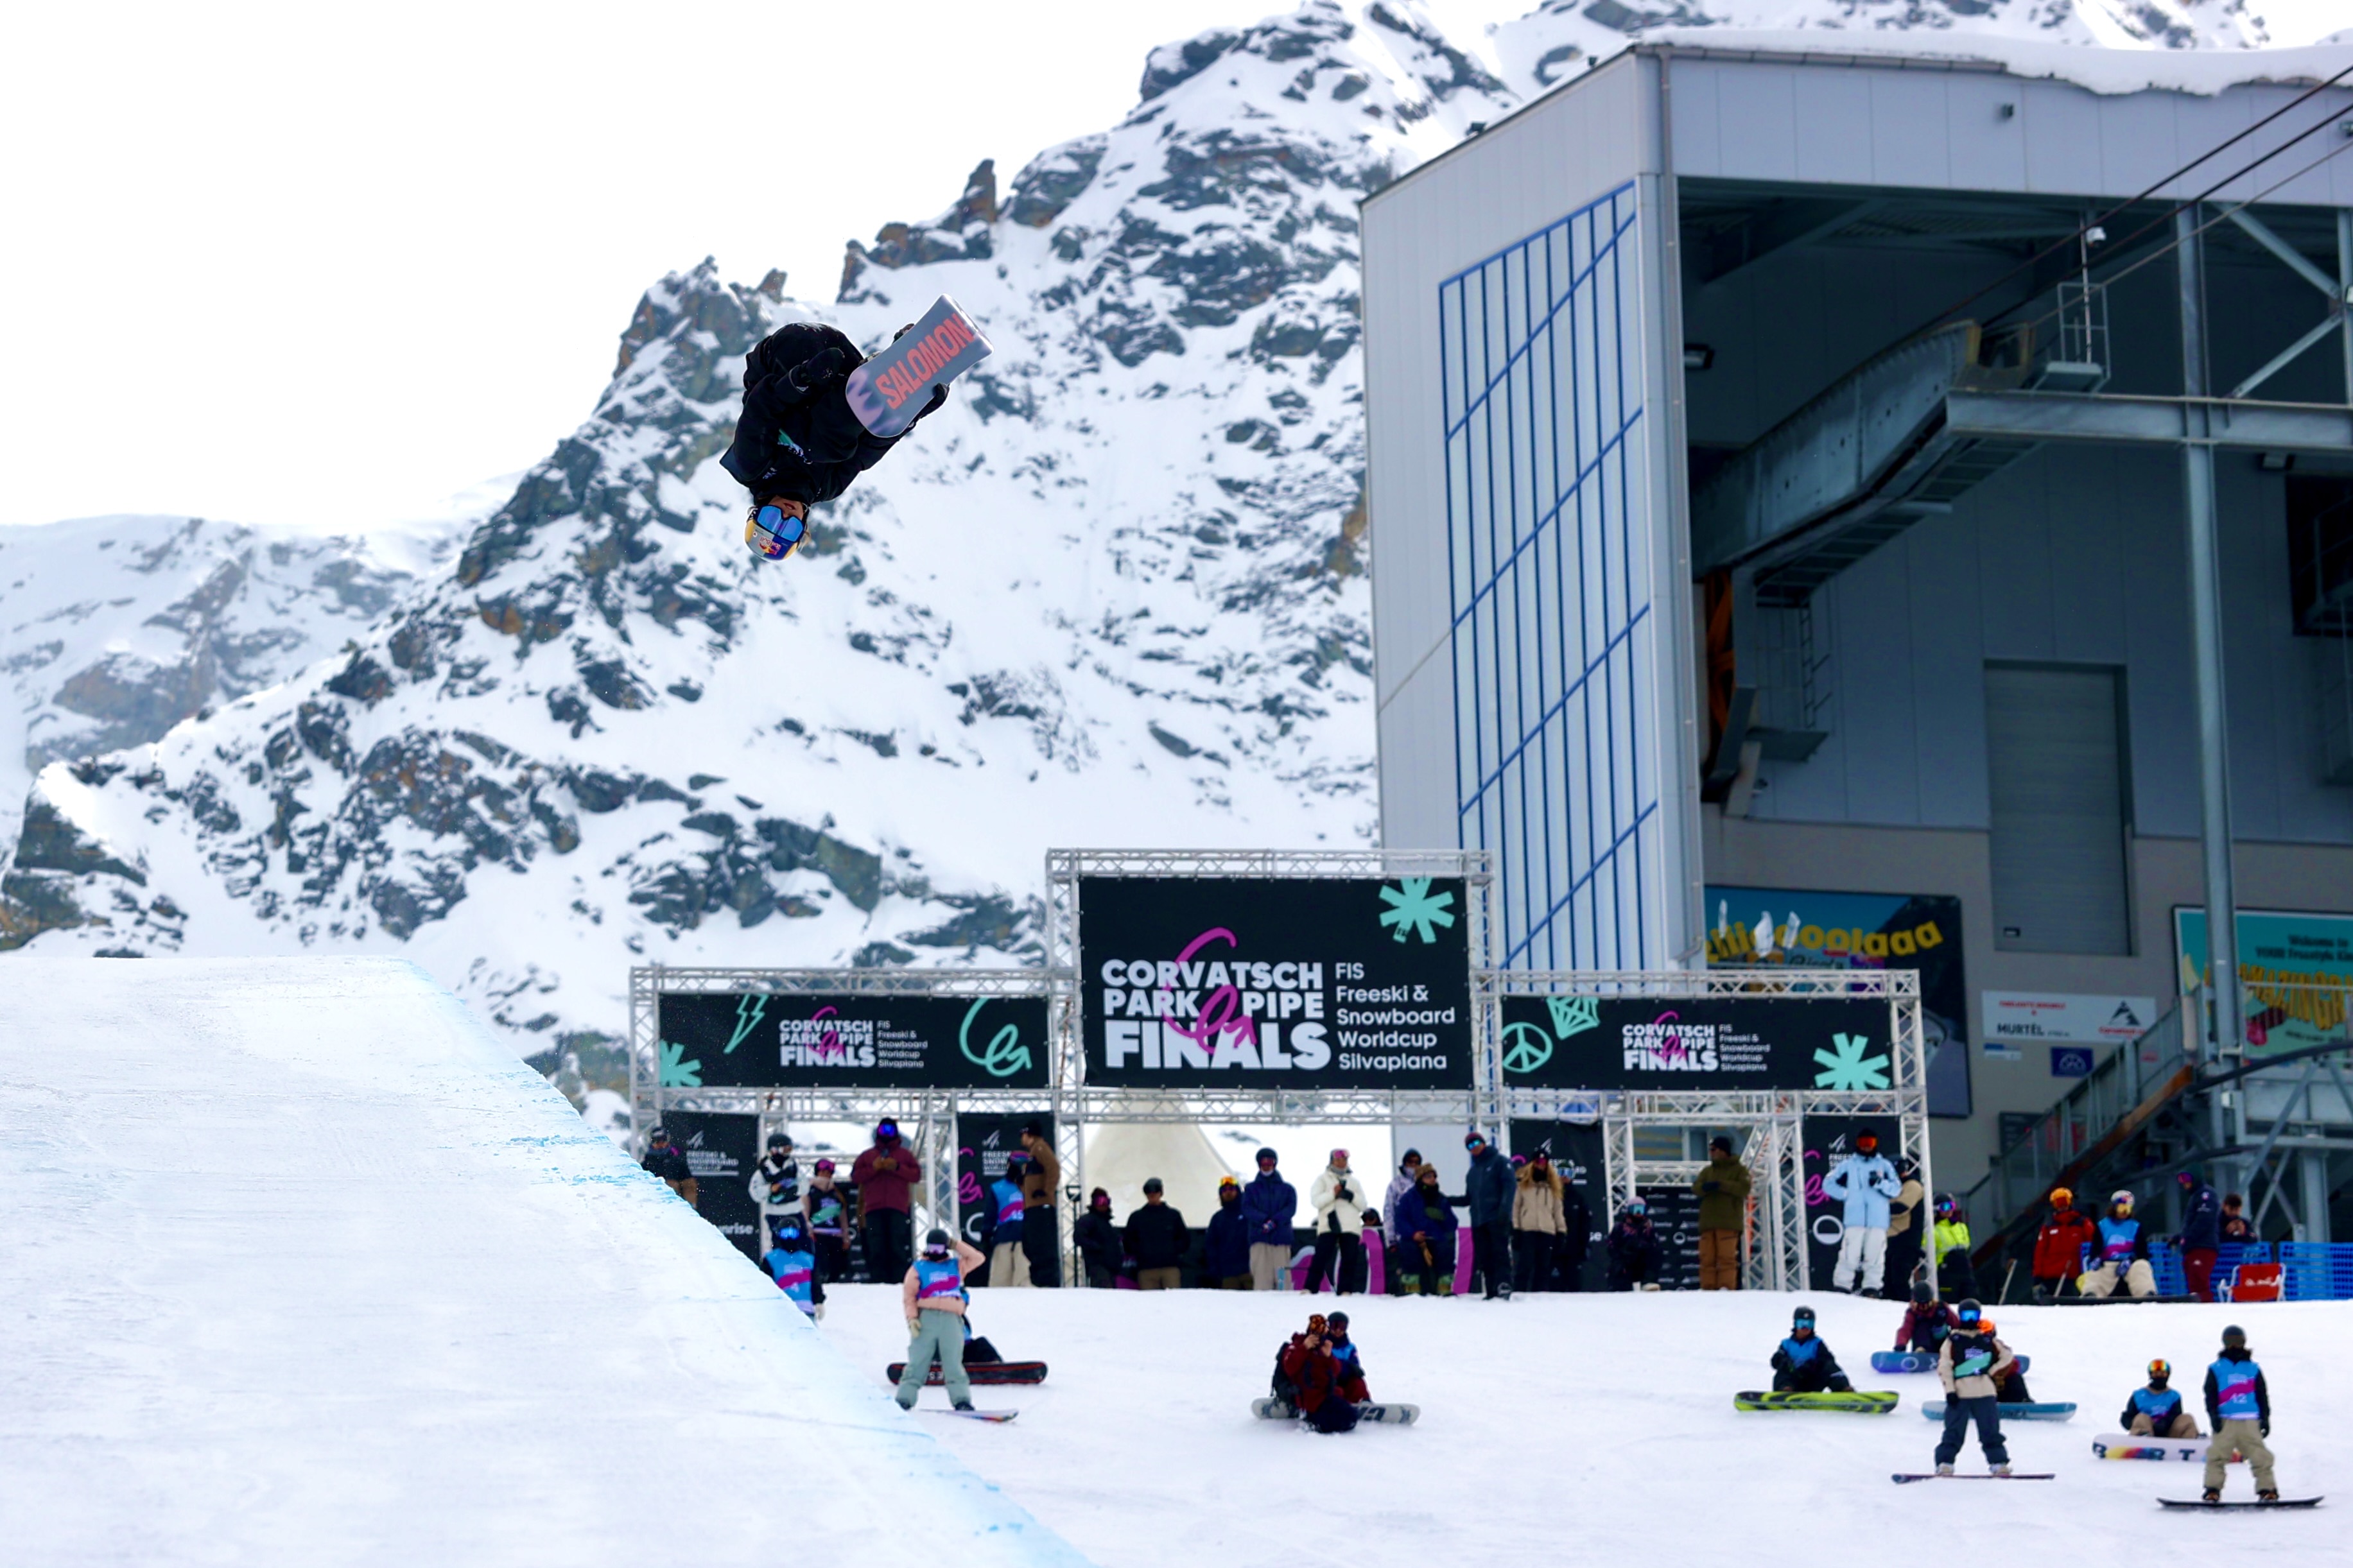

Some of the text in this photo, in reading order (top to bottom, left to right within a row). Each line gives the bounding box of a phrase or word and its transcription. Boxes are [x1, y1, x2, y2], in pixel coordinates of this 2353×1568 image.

[875, 313, 975, 409] SALOMON
[1101, 960, 1365, 990] CORVATSCH FIS
[1336, 985, 1428, 1003] Freeski &
[1104, 989, 1324, 1019] PARK PIPE
[779, 1019, 890, 1032] CORVATSCH FIS
[1337, 1007, 1455, 1026] Snowboard
[779, 1033, 874, 1046] PARK PIPE
[877, 1030, 909, 1038] Freeski
[1622, 1024, 1732, 1037] CORVATSCH FIS
[877, 1040, 928, 1049] Snowboard
[1106, 1019, 1332, 1071] FINALS
[1338, 1031, 1437, 1049] Worldcup
[1623, 1037, 1716, 1049] PARK PIPE
[780, 1045, 876, 1068] FINALS
[878, 1050, 921, 1059] Worldcup
[1339, 1053, 1447, 1072] Silvaplana
[1624, 1049, 1719, 1072] FINALS
[878, 1060, 925, 1069] Silvaplana
